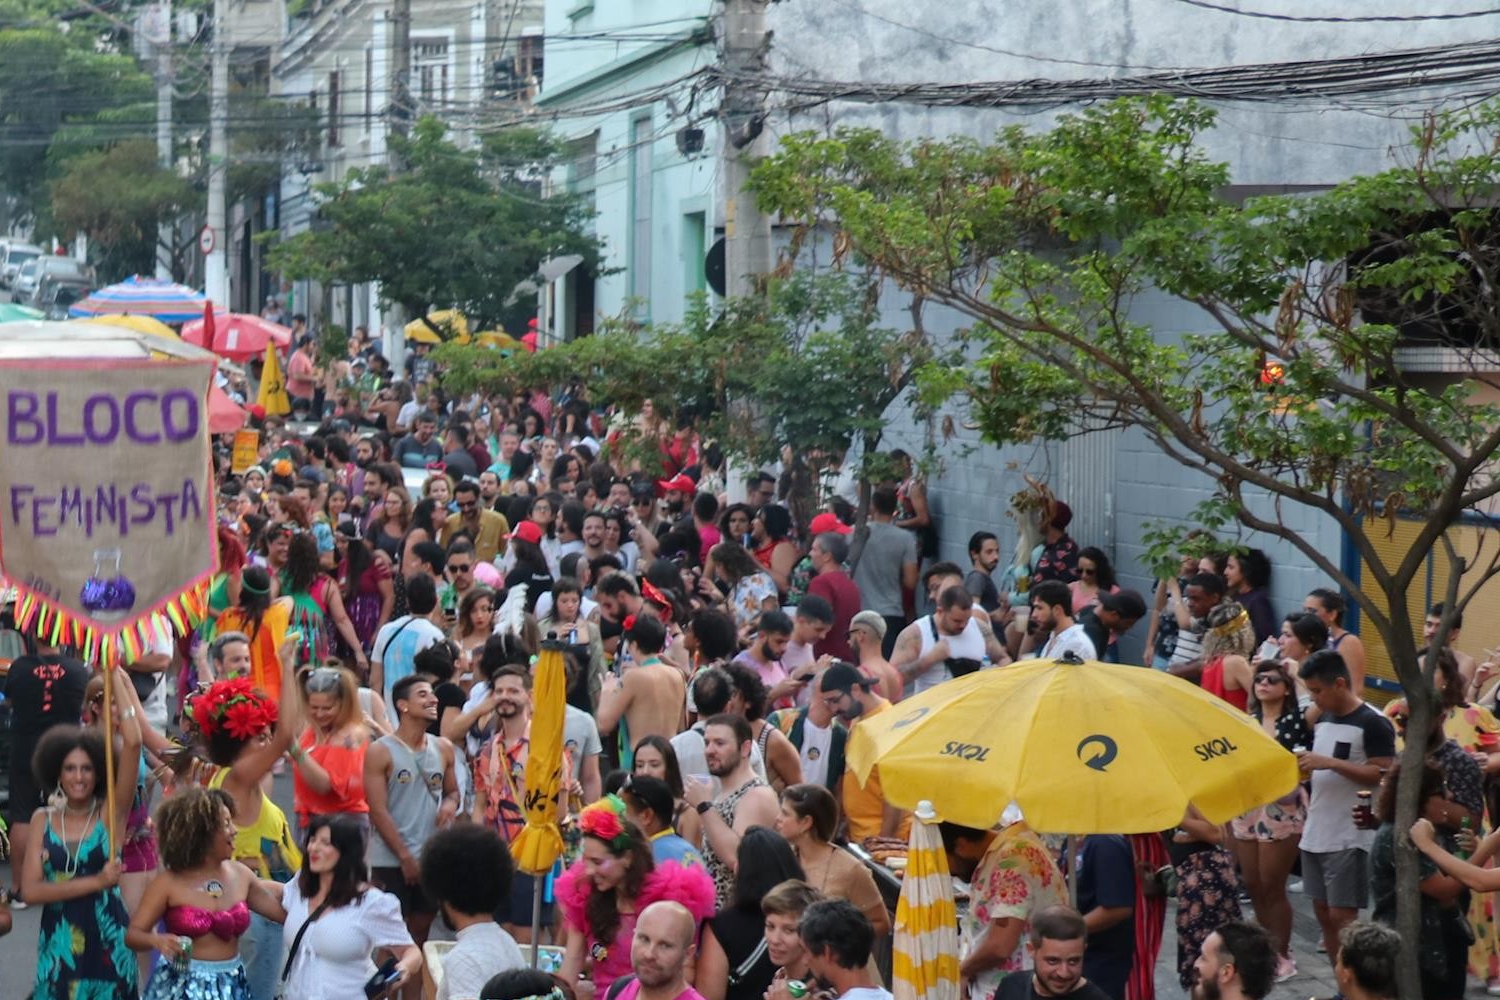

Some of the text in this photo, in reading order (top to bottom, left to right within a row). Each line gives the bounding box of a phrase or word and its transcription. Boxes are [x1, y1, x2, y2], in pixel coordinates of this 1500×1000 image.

[7, 386, 199, 446] BLOCO
[10, 479, 201, 538] FEMINISTA
[939, 741, 991, 763] SKOL
[1193, 736, 1238, 763] SKOL
